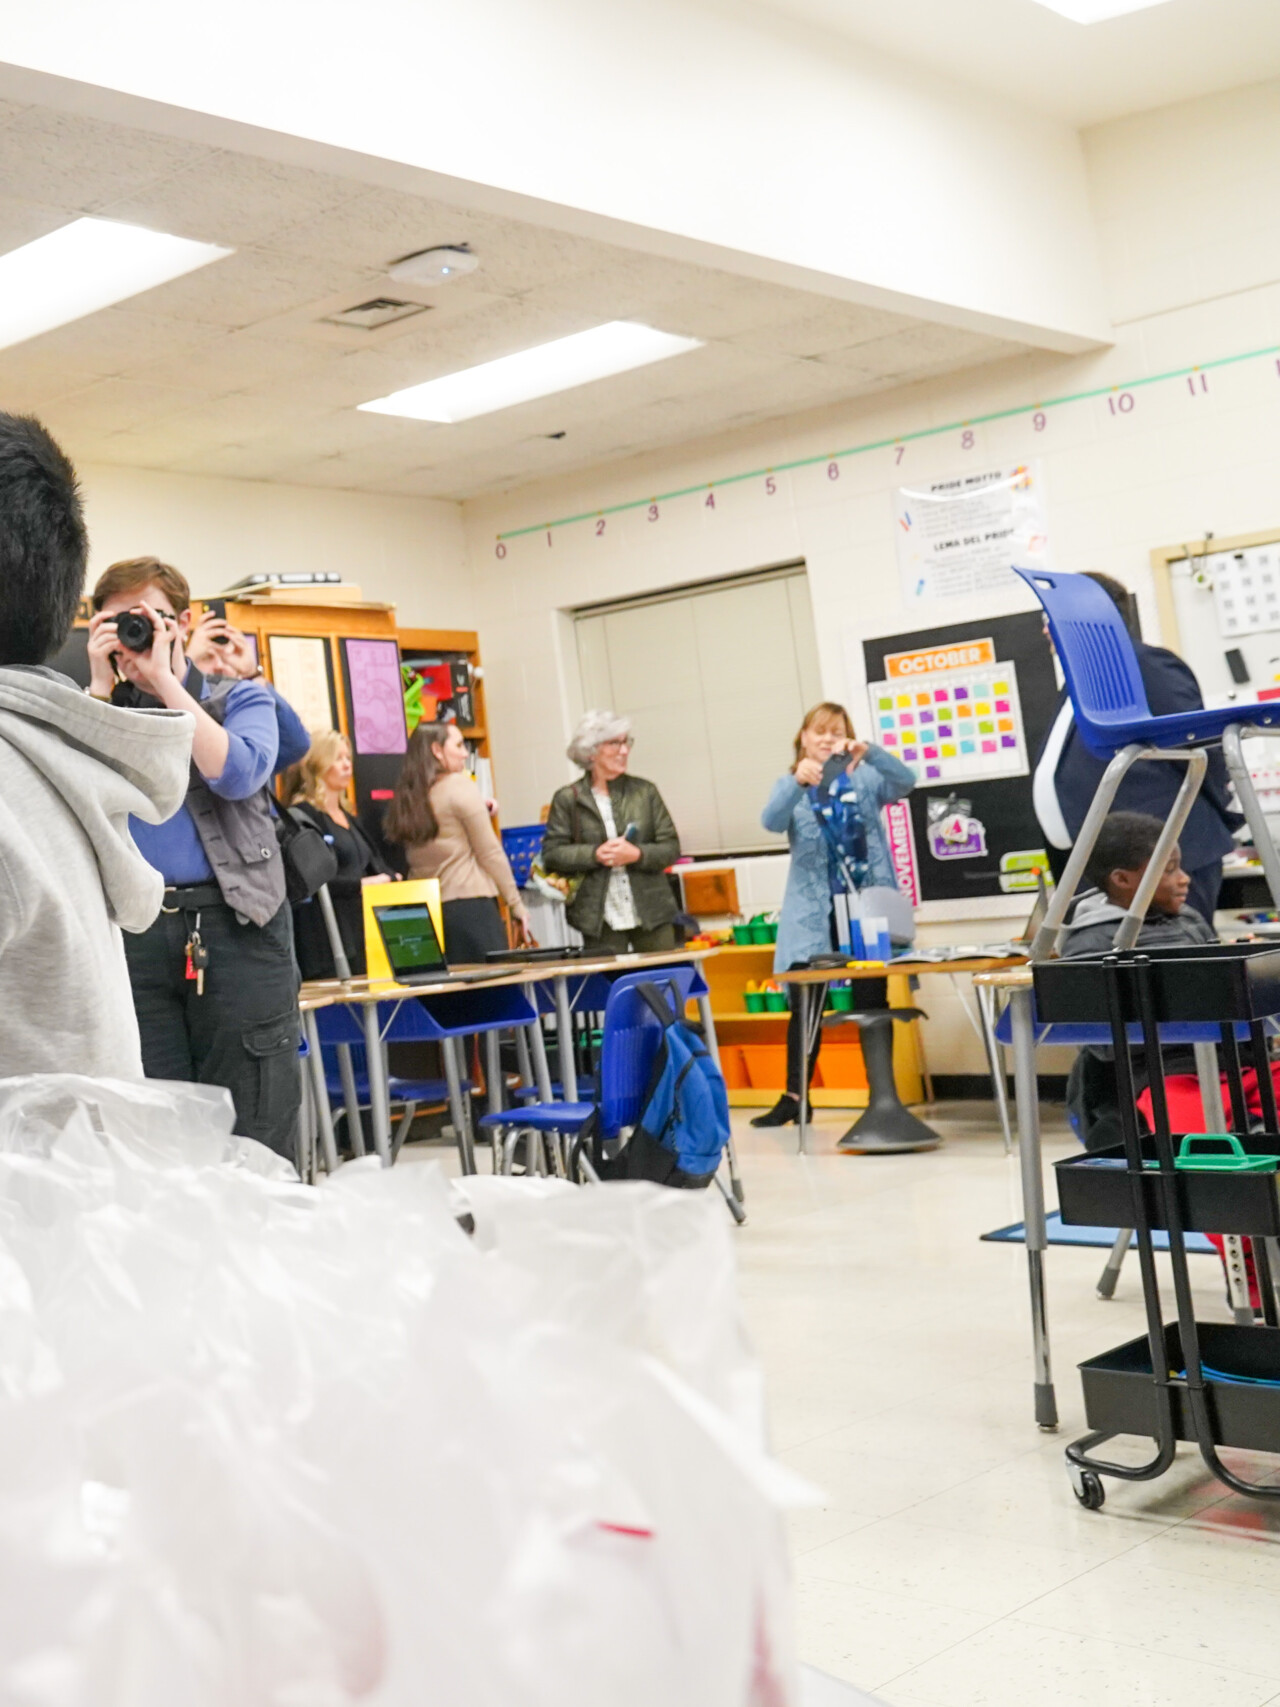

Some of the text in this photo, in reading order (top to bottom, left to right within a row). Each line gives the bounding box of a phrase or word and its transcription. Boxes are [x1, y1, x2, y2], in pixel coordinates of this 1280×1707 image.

[595, 519, 607, 536] 2
[647, 504, 659, 522] 3
[704, 492, 716, 510] 4
[764, 476, 778, 496] 5
[826, 461, 841, 481] 6
[894, 446, 908, 466] 7
[961, 429, 975, 451] 8
[1032, 411, 1047, 433] 9
[1108, 391, 1135, 416] 10
[1187, 373, 1208, 396] 11
[931, 471, 1002, 493] PRIDE MOTTO
[933, 539, 961, 552] LEMA
[963, 536, 981, 547] DEL
[898, 647, 981, 674] OCTOBER
